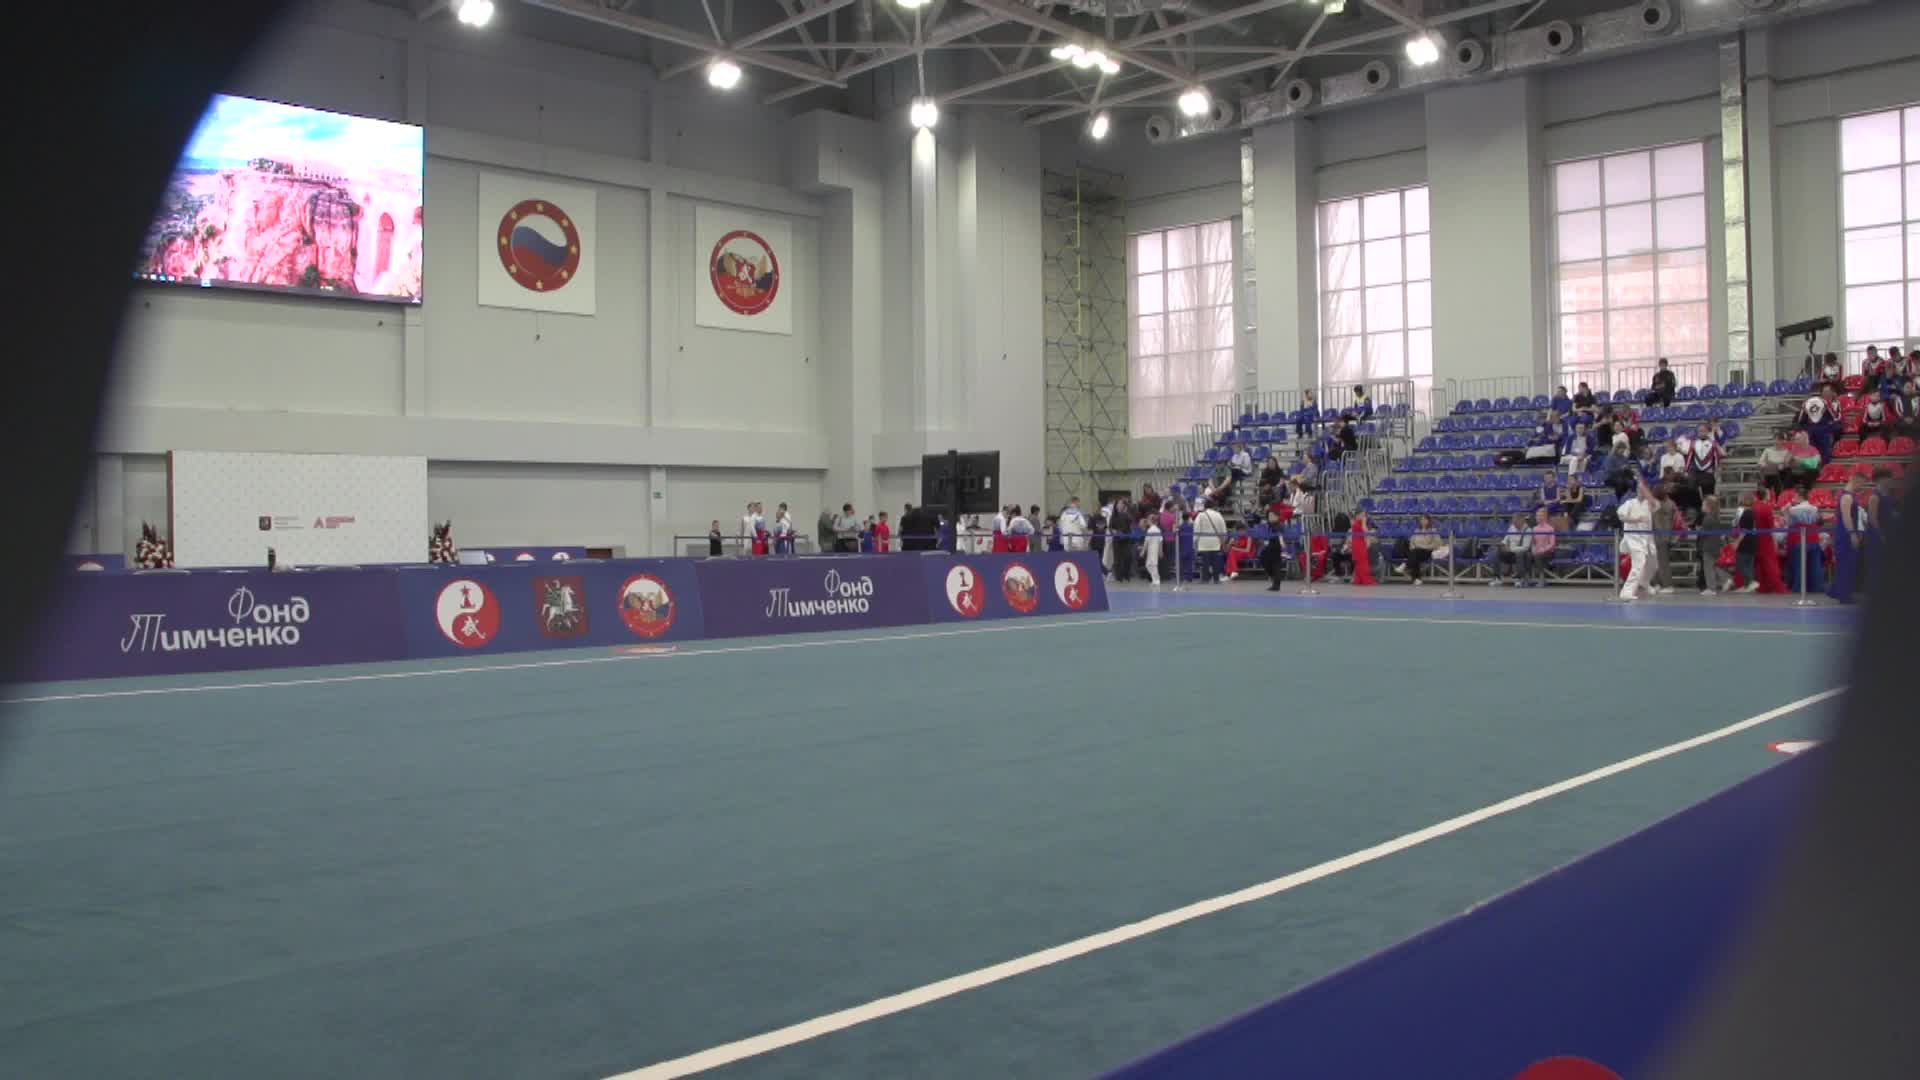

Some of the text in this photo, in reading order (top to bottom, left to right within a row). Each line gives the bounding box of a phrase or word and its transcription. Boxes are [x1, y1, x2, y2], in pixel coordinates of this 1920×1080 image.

[824, 568, 873, 597] Фонд
[228, 586, 310, 624] Фонд
[766, 588, 869, 617] Тимченко
[120, 614, 300, 652] Тимченко
